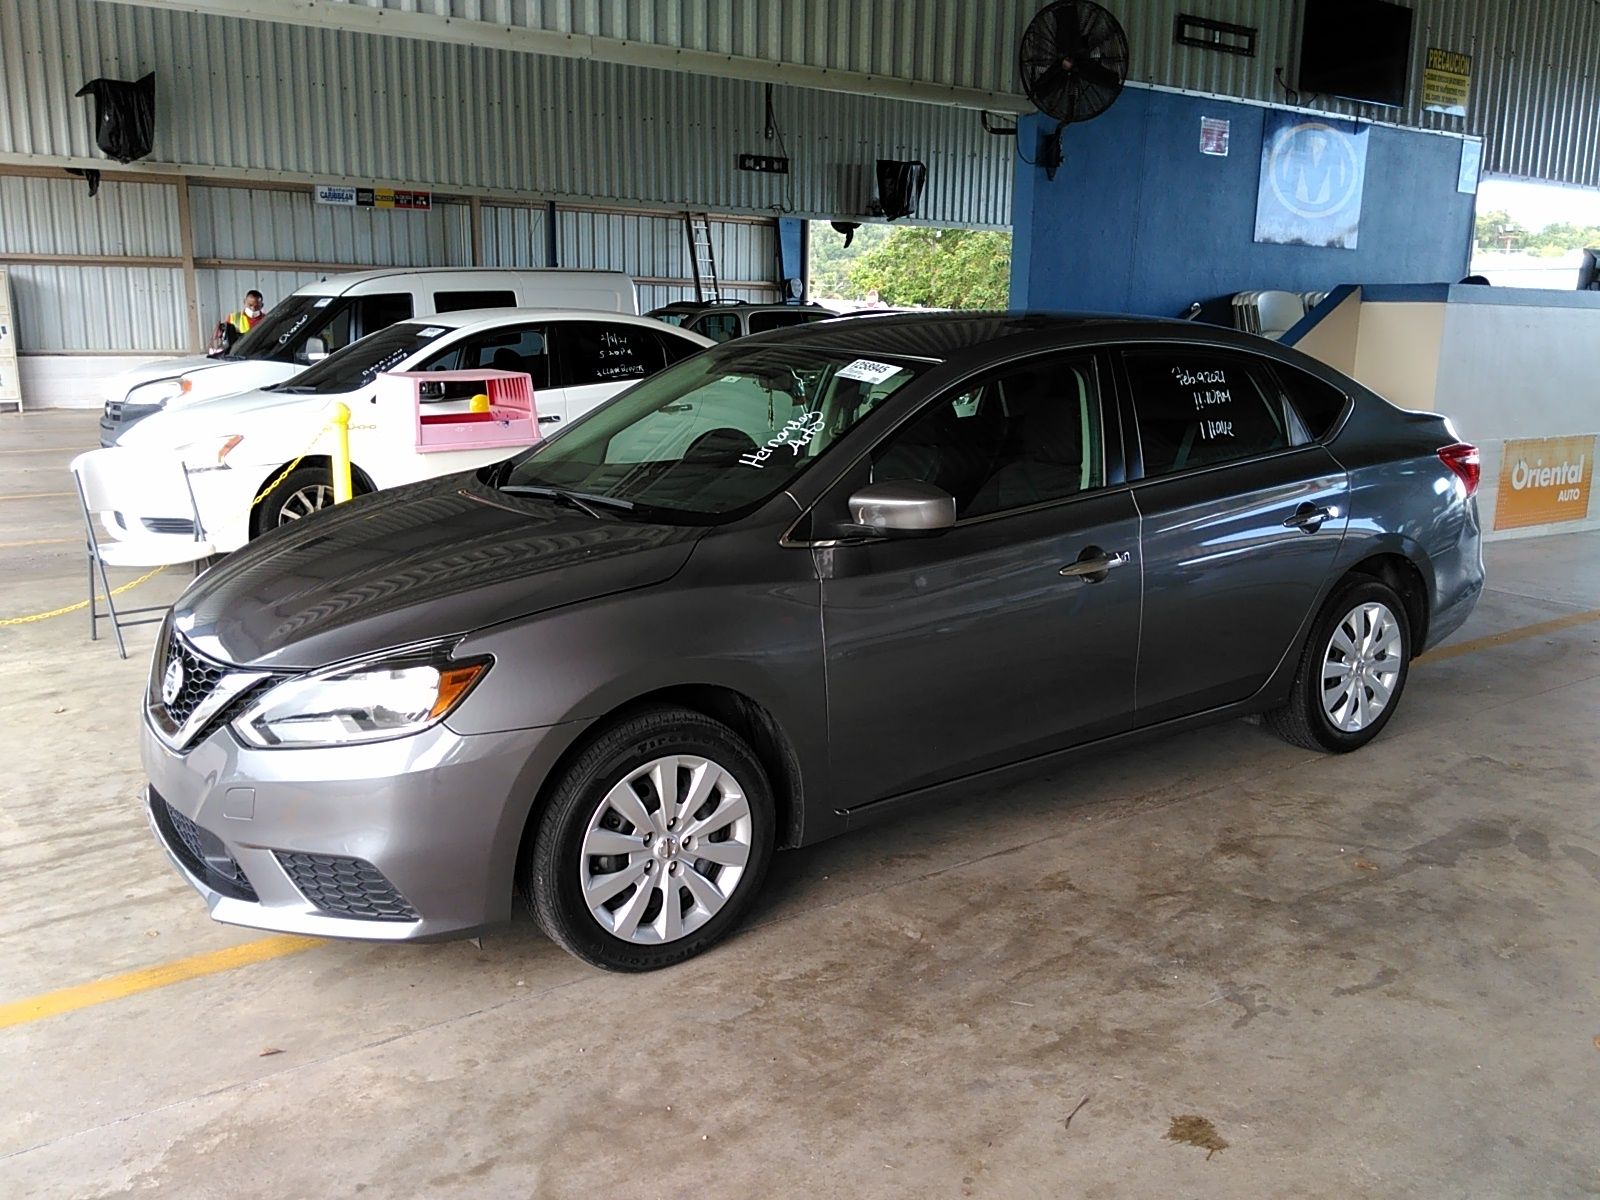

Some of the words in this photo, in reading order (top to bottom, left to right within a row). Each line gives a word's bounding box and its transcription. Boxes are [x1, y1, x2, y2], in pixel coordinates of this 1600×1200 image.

[1427, 49, 1471, 75] PRECAUCION
[319, 190, 354, 201] CARIBBEAN
[787, 421, 825, 456] Auto
[1511, 454, 1585, 491] Oriental
[1557, 488, 1580, 502] AUTO
